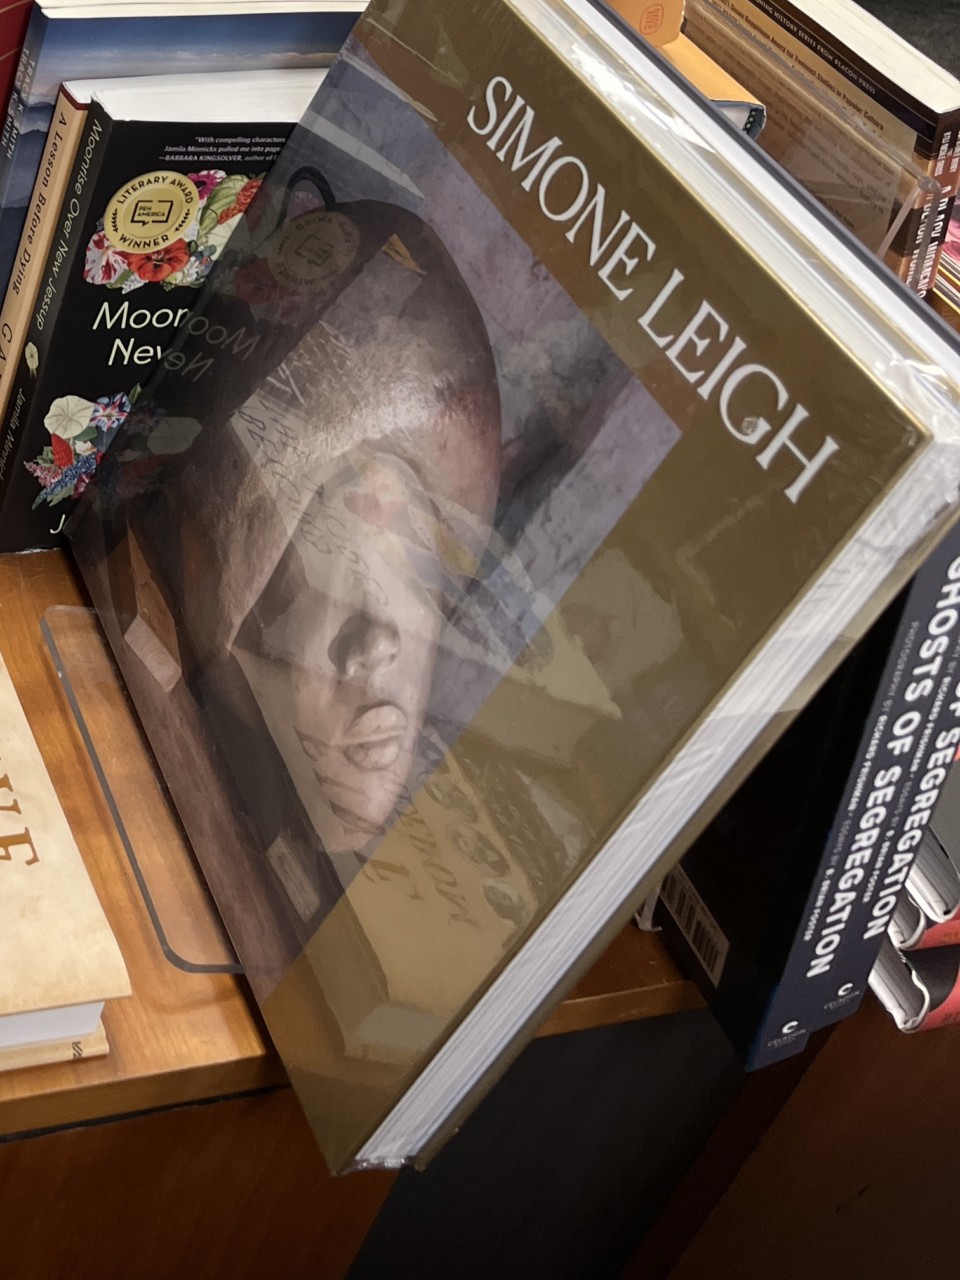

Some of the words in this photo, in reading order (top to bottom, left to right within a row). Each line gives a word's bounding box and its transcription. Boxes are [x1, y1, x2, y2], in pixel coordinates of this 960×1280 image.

[774, 11, 797, 33] HISTORY
[798, 30, 816, 47] SERIES
[817, 45, 833, 62] FROM
[835, 58, 858, 80] BEACON
[859, 77, 876, 95] PRESS
[21, 60, 35, 102] TRACY
[6, 118, 20, 159] SMITH
[58, 116, 68, 126] A
[42, 132, 62, 188] Lesson
[75, 116, 103, 205] Moonrise
[198, 155, 243, 163] KINGSOLVER,
[117, 175, 168, 205] LITERARY
[169, 178, 193, 205] AWARD
[24, 195, 47, 246] Before
[63, 201, 83, 242] Over
[119, 233, 170, 249] WINNER
[12, 249, 33, 296] Dying
[51, 243, 71, 278] New
[36, 277, 60, 331] Jessup
[467, 76, 656, 300] SIMONE
[638, 268, 839, 504] LEIGH
[12, 387, 25, 431] Jamila
[887, 711, 921, 756] OF
[863, 726, 960, 940] SEGREGATION
[806, 766, 902, 978] SEGREGATION
